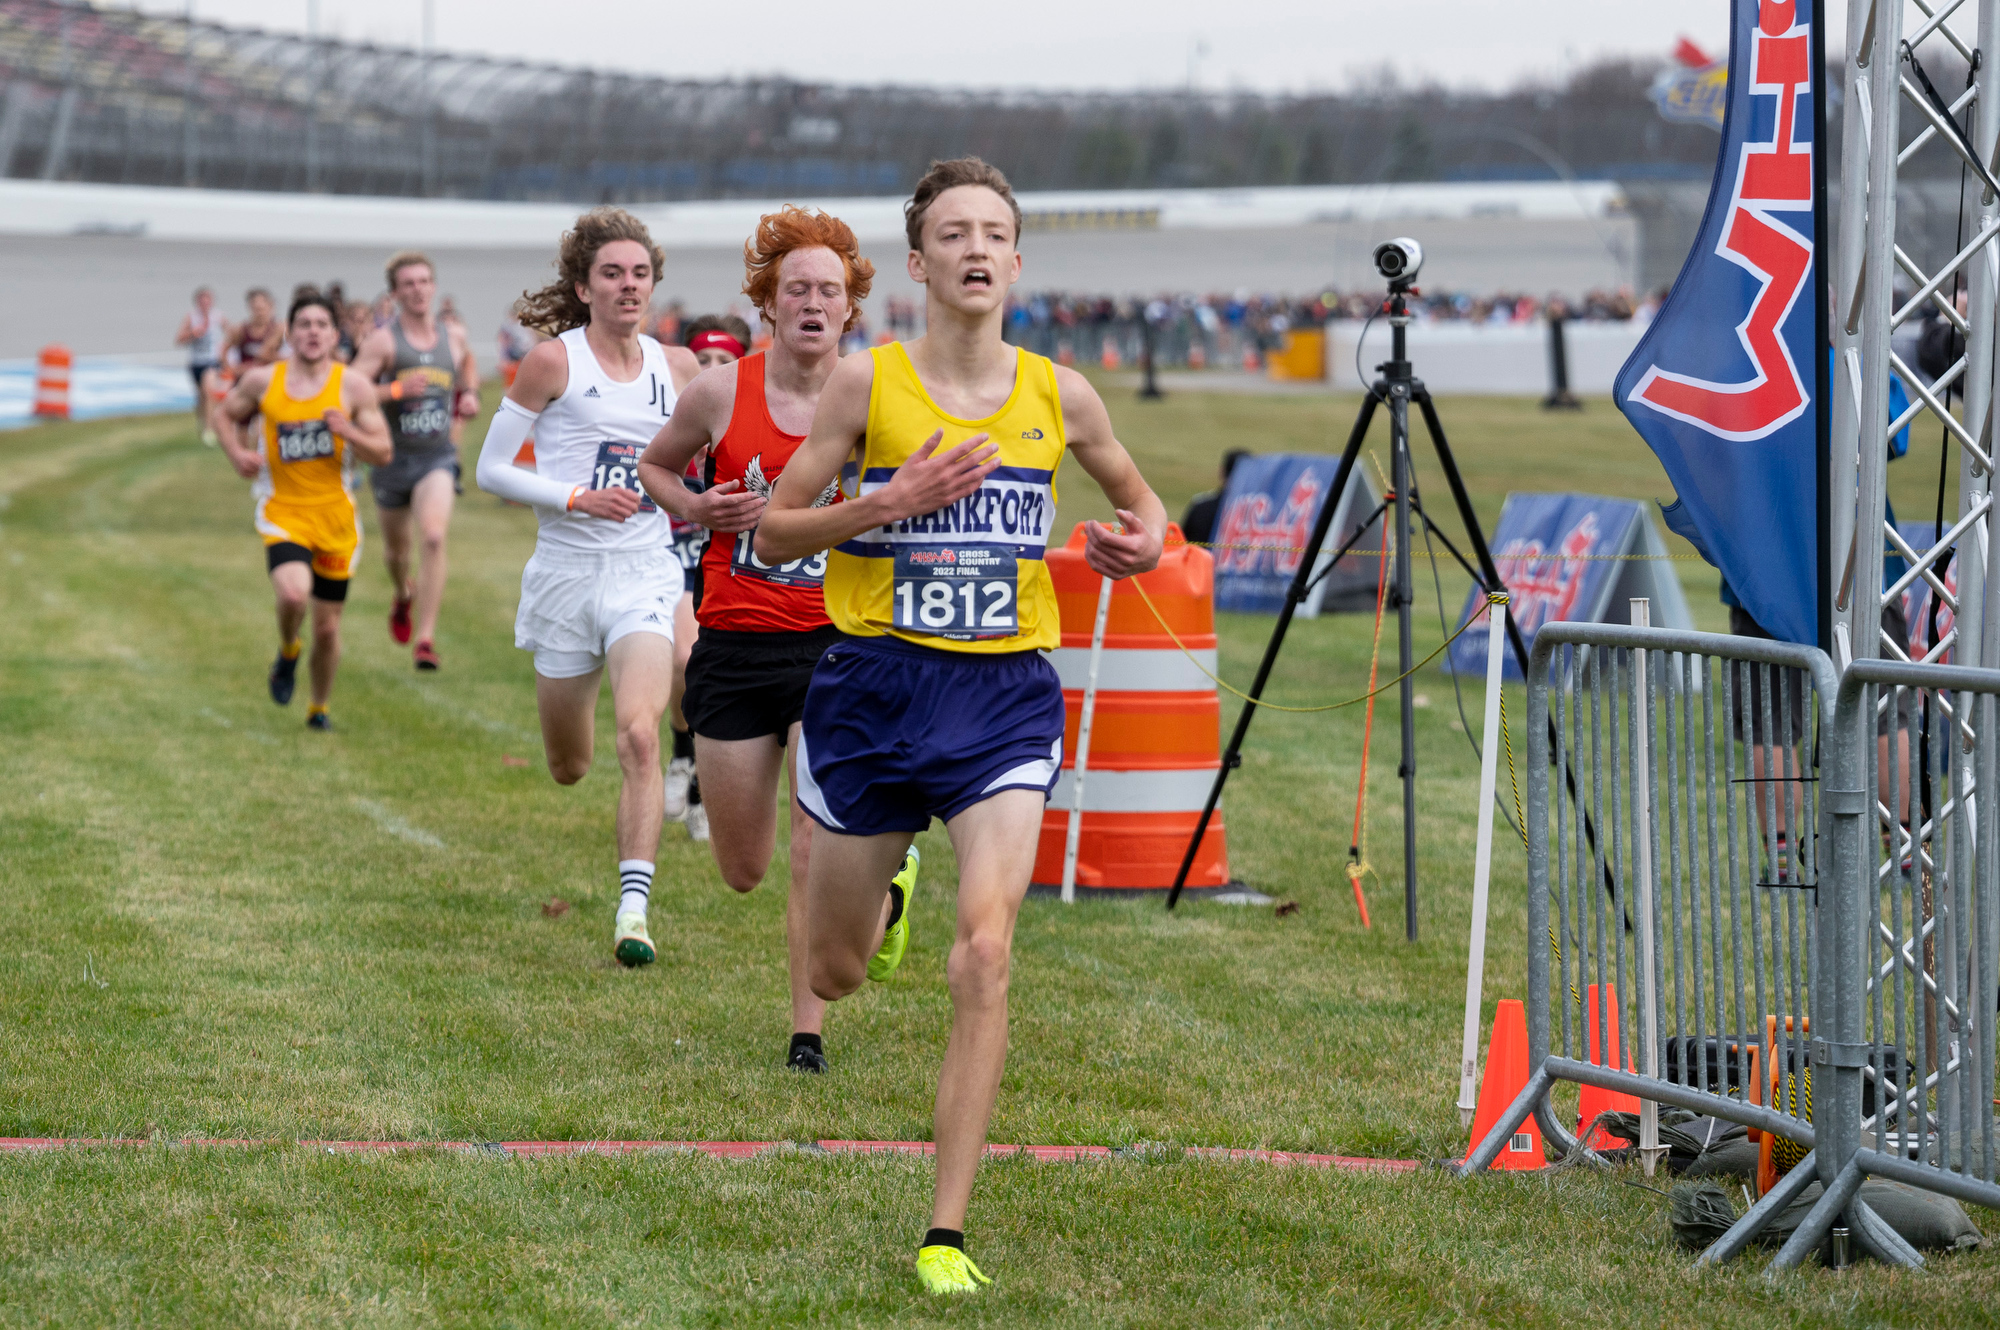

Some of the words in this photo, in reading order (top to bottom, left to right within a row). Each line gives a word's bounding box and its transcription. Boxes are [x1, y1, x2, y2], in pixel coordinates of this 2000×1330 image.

[763, 465, 785, 473] SUM
[737, 530, 828, 577] 13
[958, 550, 990, 558] CROSS
[958, 558, 1000, 566] COUNTRY
[932, 567, 955, 576] 2022
[956, 567, 981, 576] FINAL
[896, 581, 1013, 628] 1812
